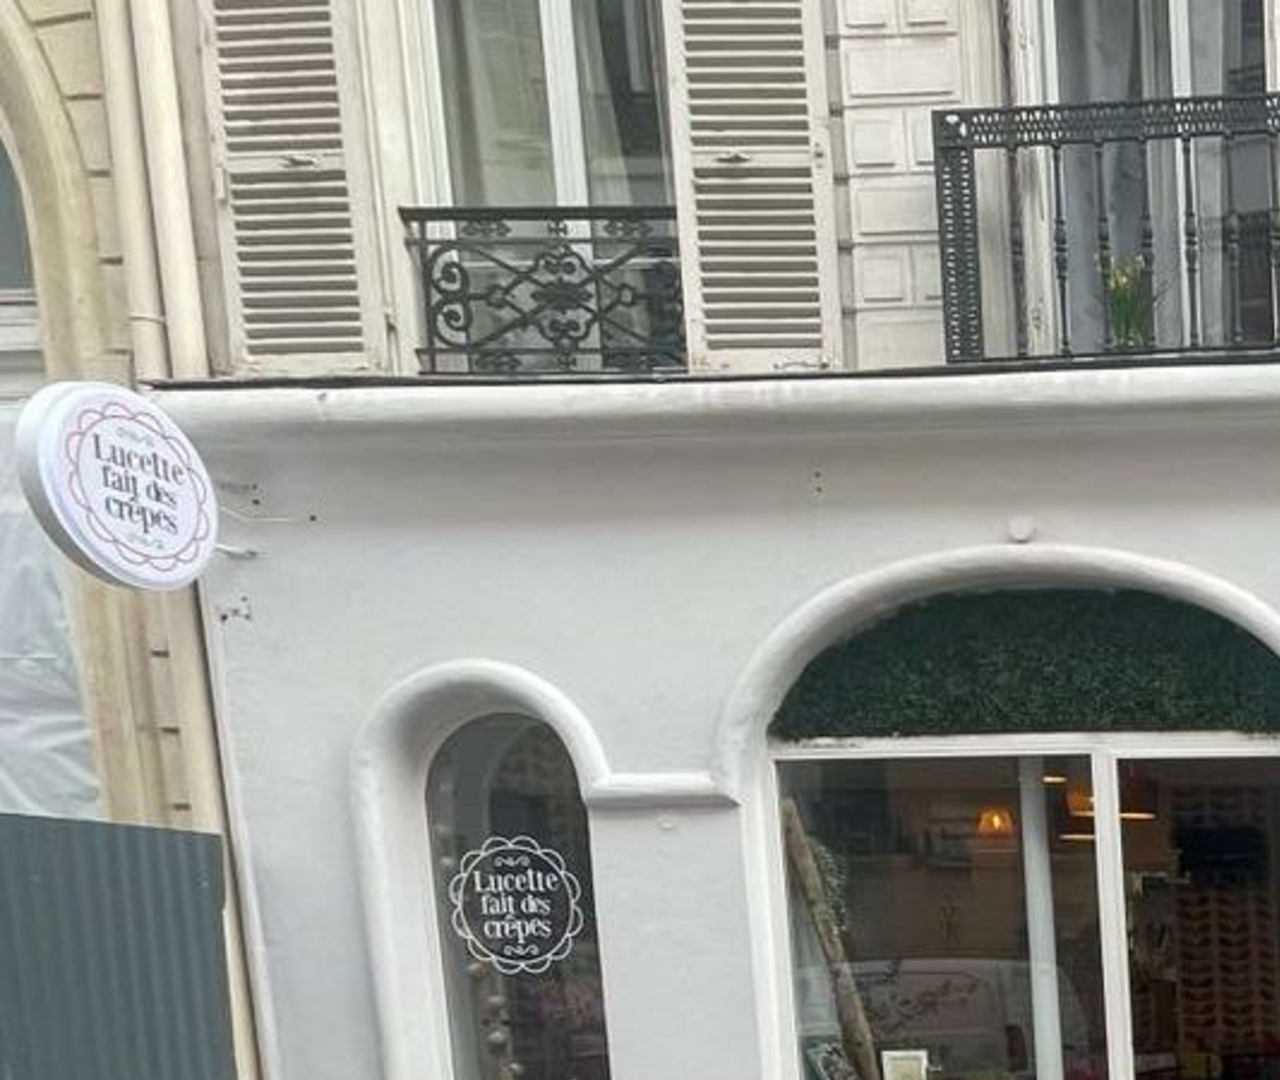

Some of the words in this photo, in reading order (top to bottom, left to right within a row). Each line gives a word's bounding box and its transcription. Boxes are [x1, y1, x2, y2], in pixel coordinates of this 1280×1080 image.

[93, 434, 186, 485] Lucette
[102, 466, 139, 497] fait
[146, 481, 177, 508] des
[105, 496, 179, 536] crêpes
[473, 869, 560, 893] Lucette
[480, 894, 516, 915] fait
[521, 894, 552, 915] des
[484, 915, 553, 943] crêpes
